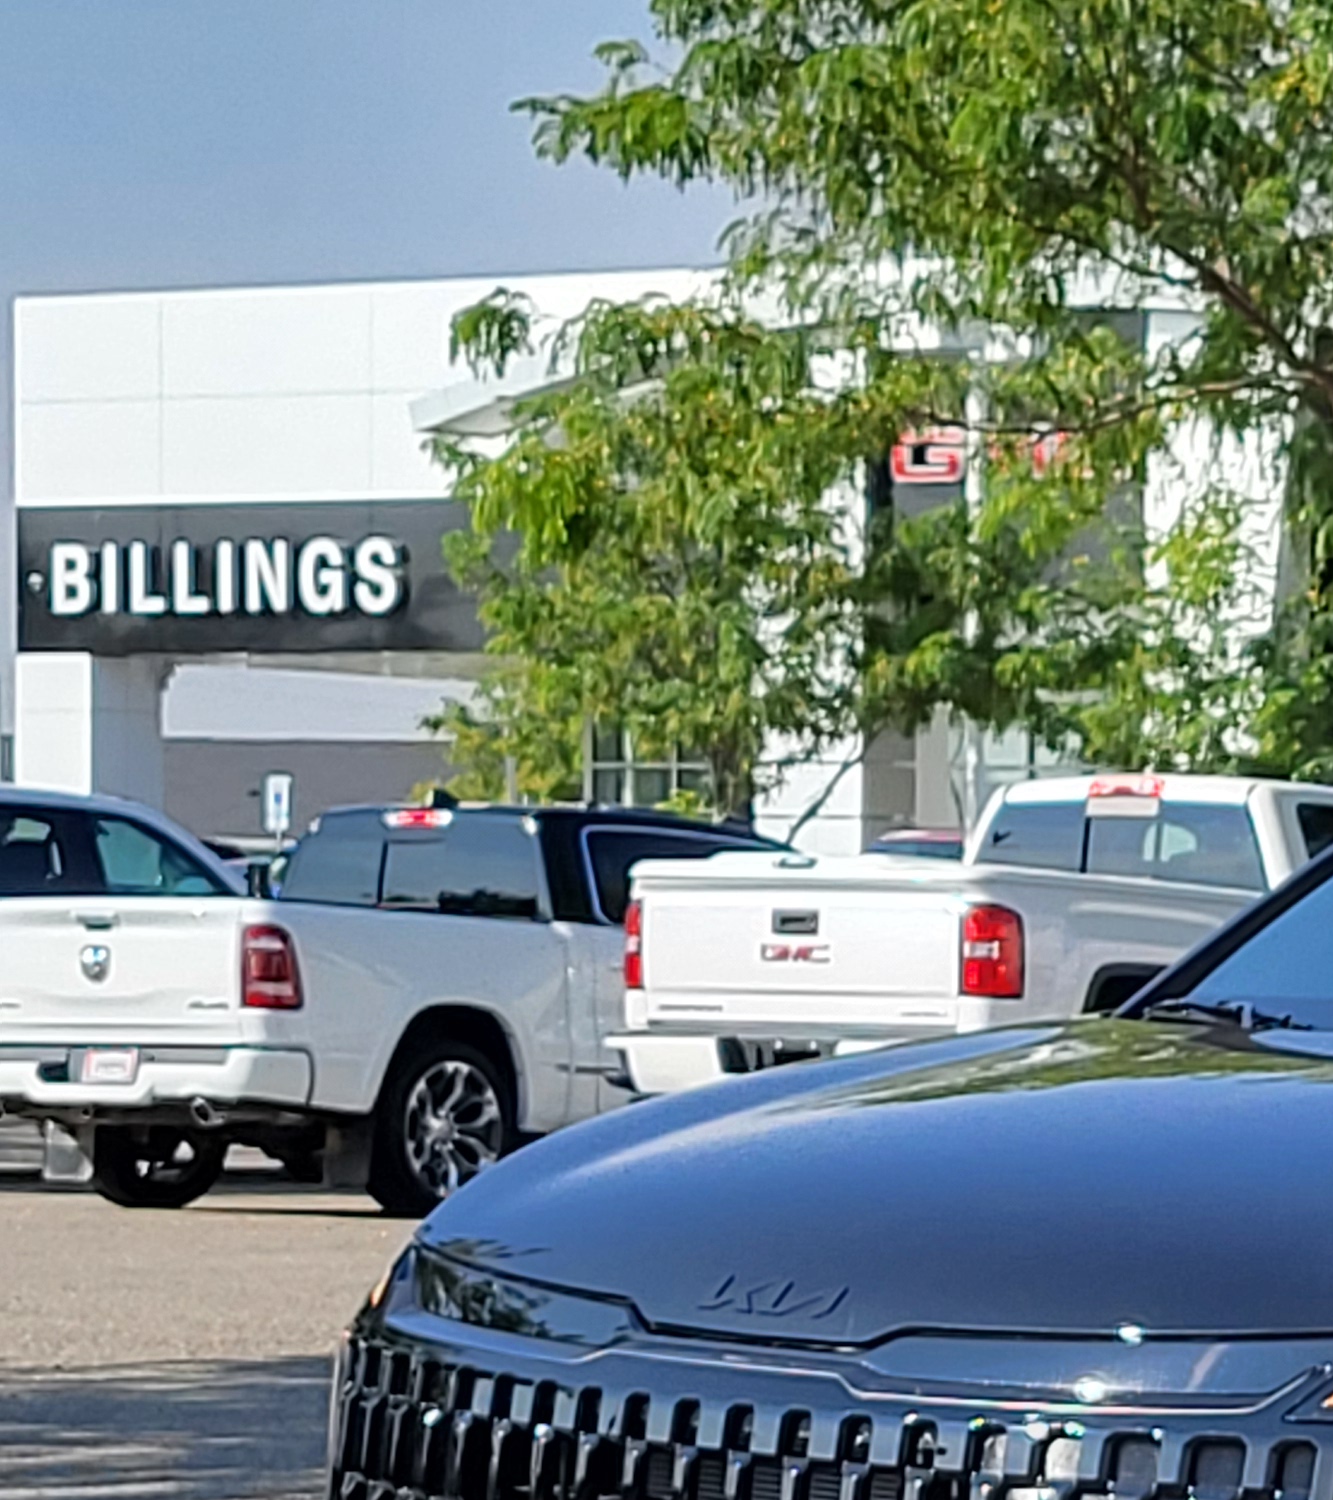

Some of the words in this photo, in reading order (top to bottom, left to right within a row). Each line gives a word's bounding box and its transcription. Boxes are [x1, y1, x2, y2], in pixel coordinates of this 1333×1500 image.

[50, 536, 398, 615] BILLINGS
[760, 944, 830, 963] GMC
[698, 1274, 850, 1320] KIA
